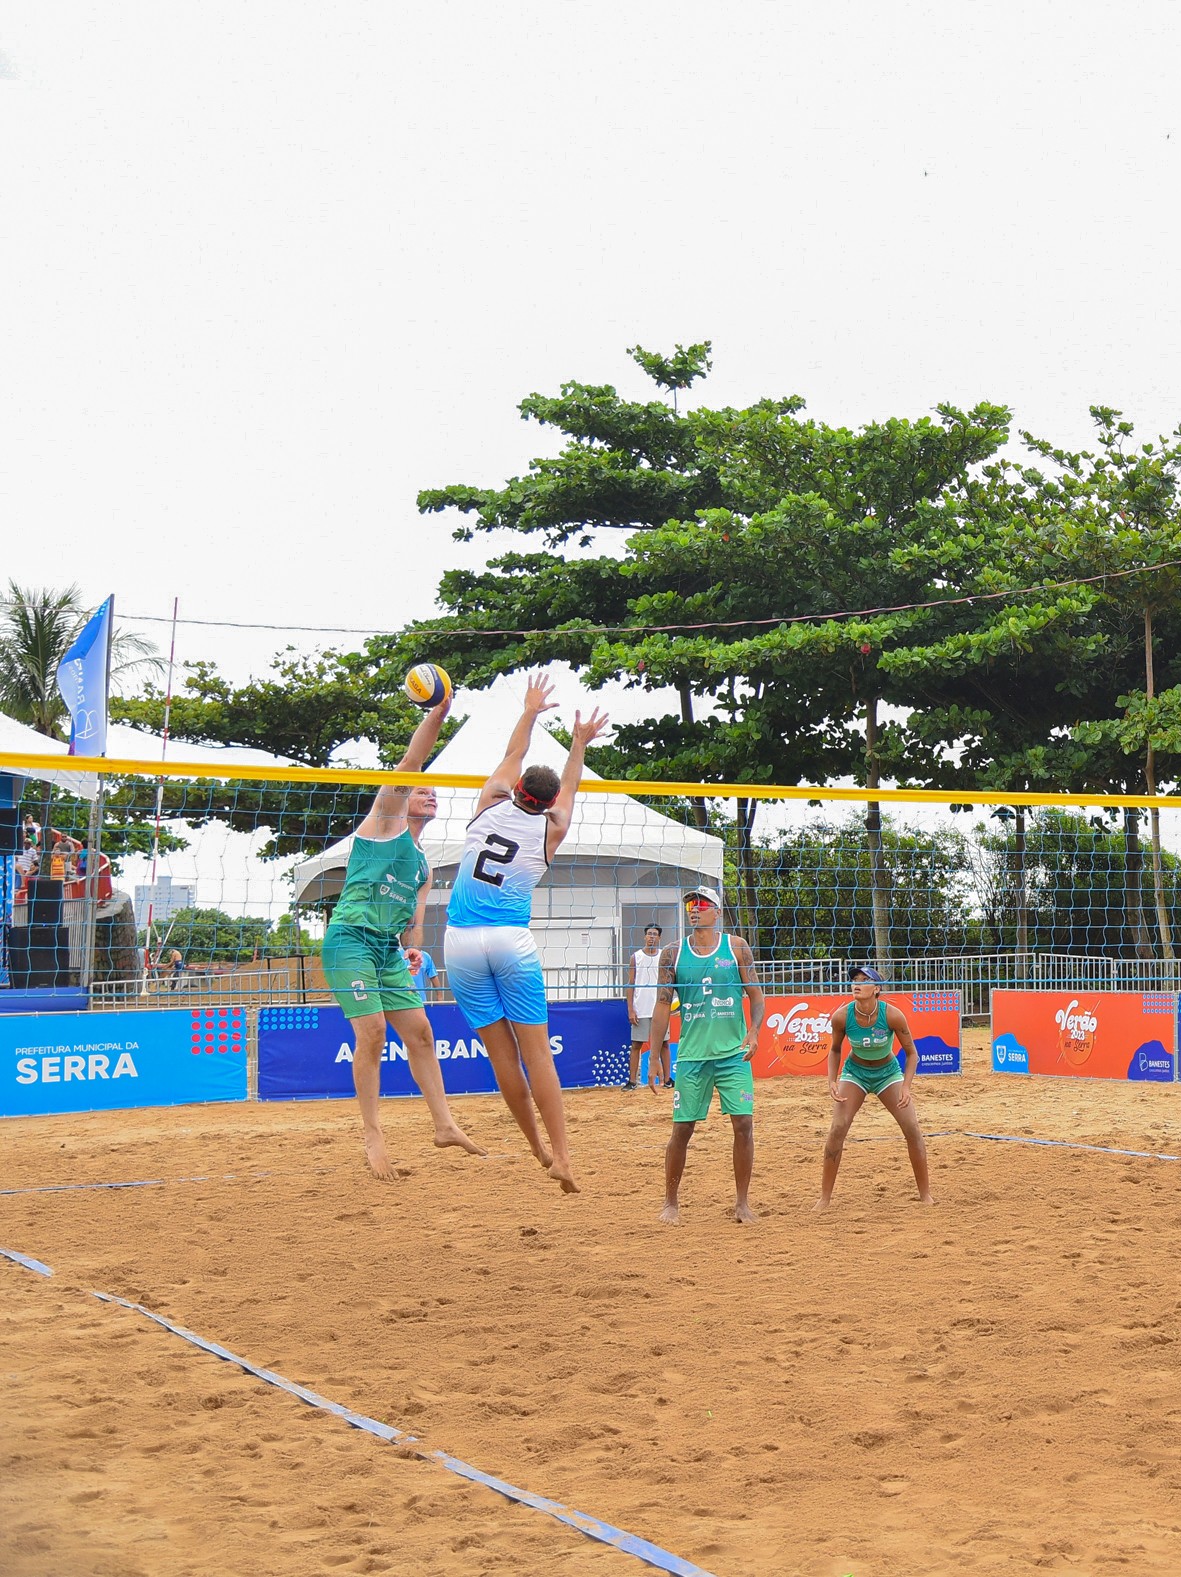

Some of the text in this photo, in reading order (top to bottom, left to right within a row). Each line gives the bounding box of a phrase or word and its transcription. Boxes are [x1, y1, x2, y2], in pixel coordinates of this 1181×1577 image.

[473, 833, 521, 888] 2
[351, 979, 368, 1001] 2
[702, 976, 713, 995] 2
[1055, 999, 1098, 1033] Verão
[794, 1032, 820, 1043] 2023
[863, 1037, 871, 1048] 2
[15, 1041, 139, 1056] PREFEITURA MUNICIPAL DA
[783, 1041, 828, 1055] na Serra
[921, 1054, 954, 1062] BANESTES
[1007, 1052, 1027, 1063] SERRA
[1148, 1060, 1170, 1069] BANESTES
[15, 1052, 139, 1085] SERRA
